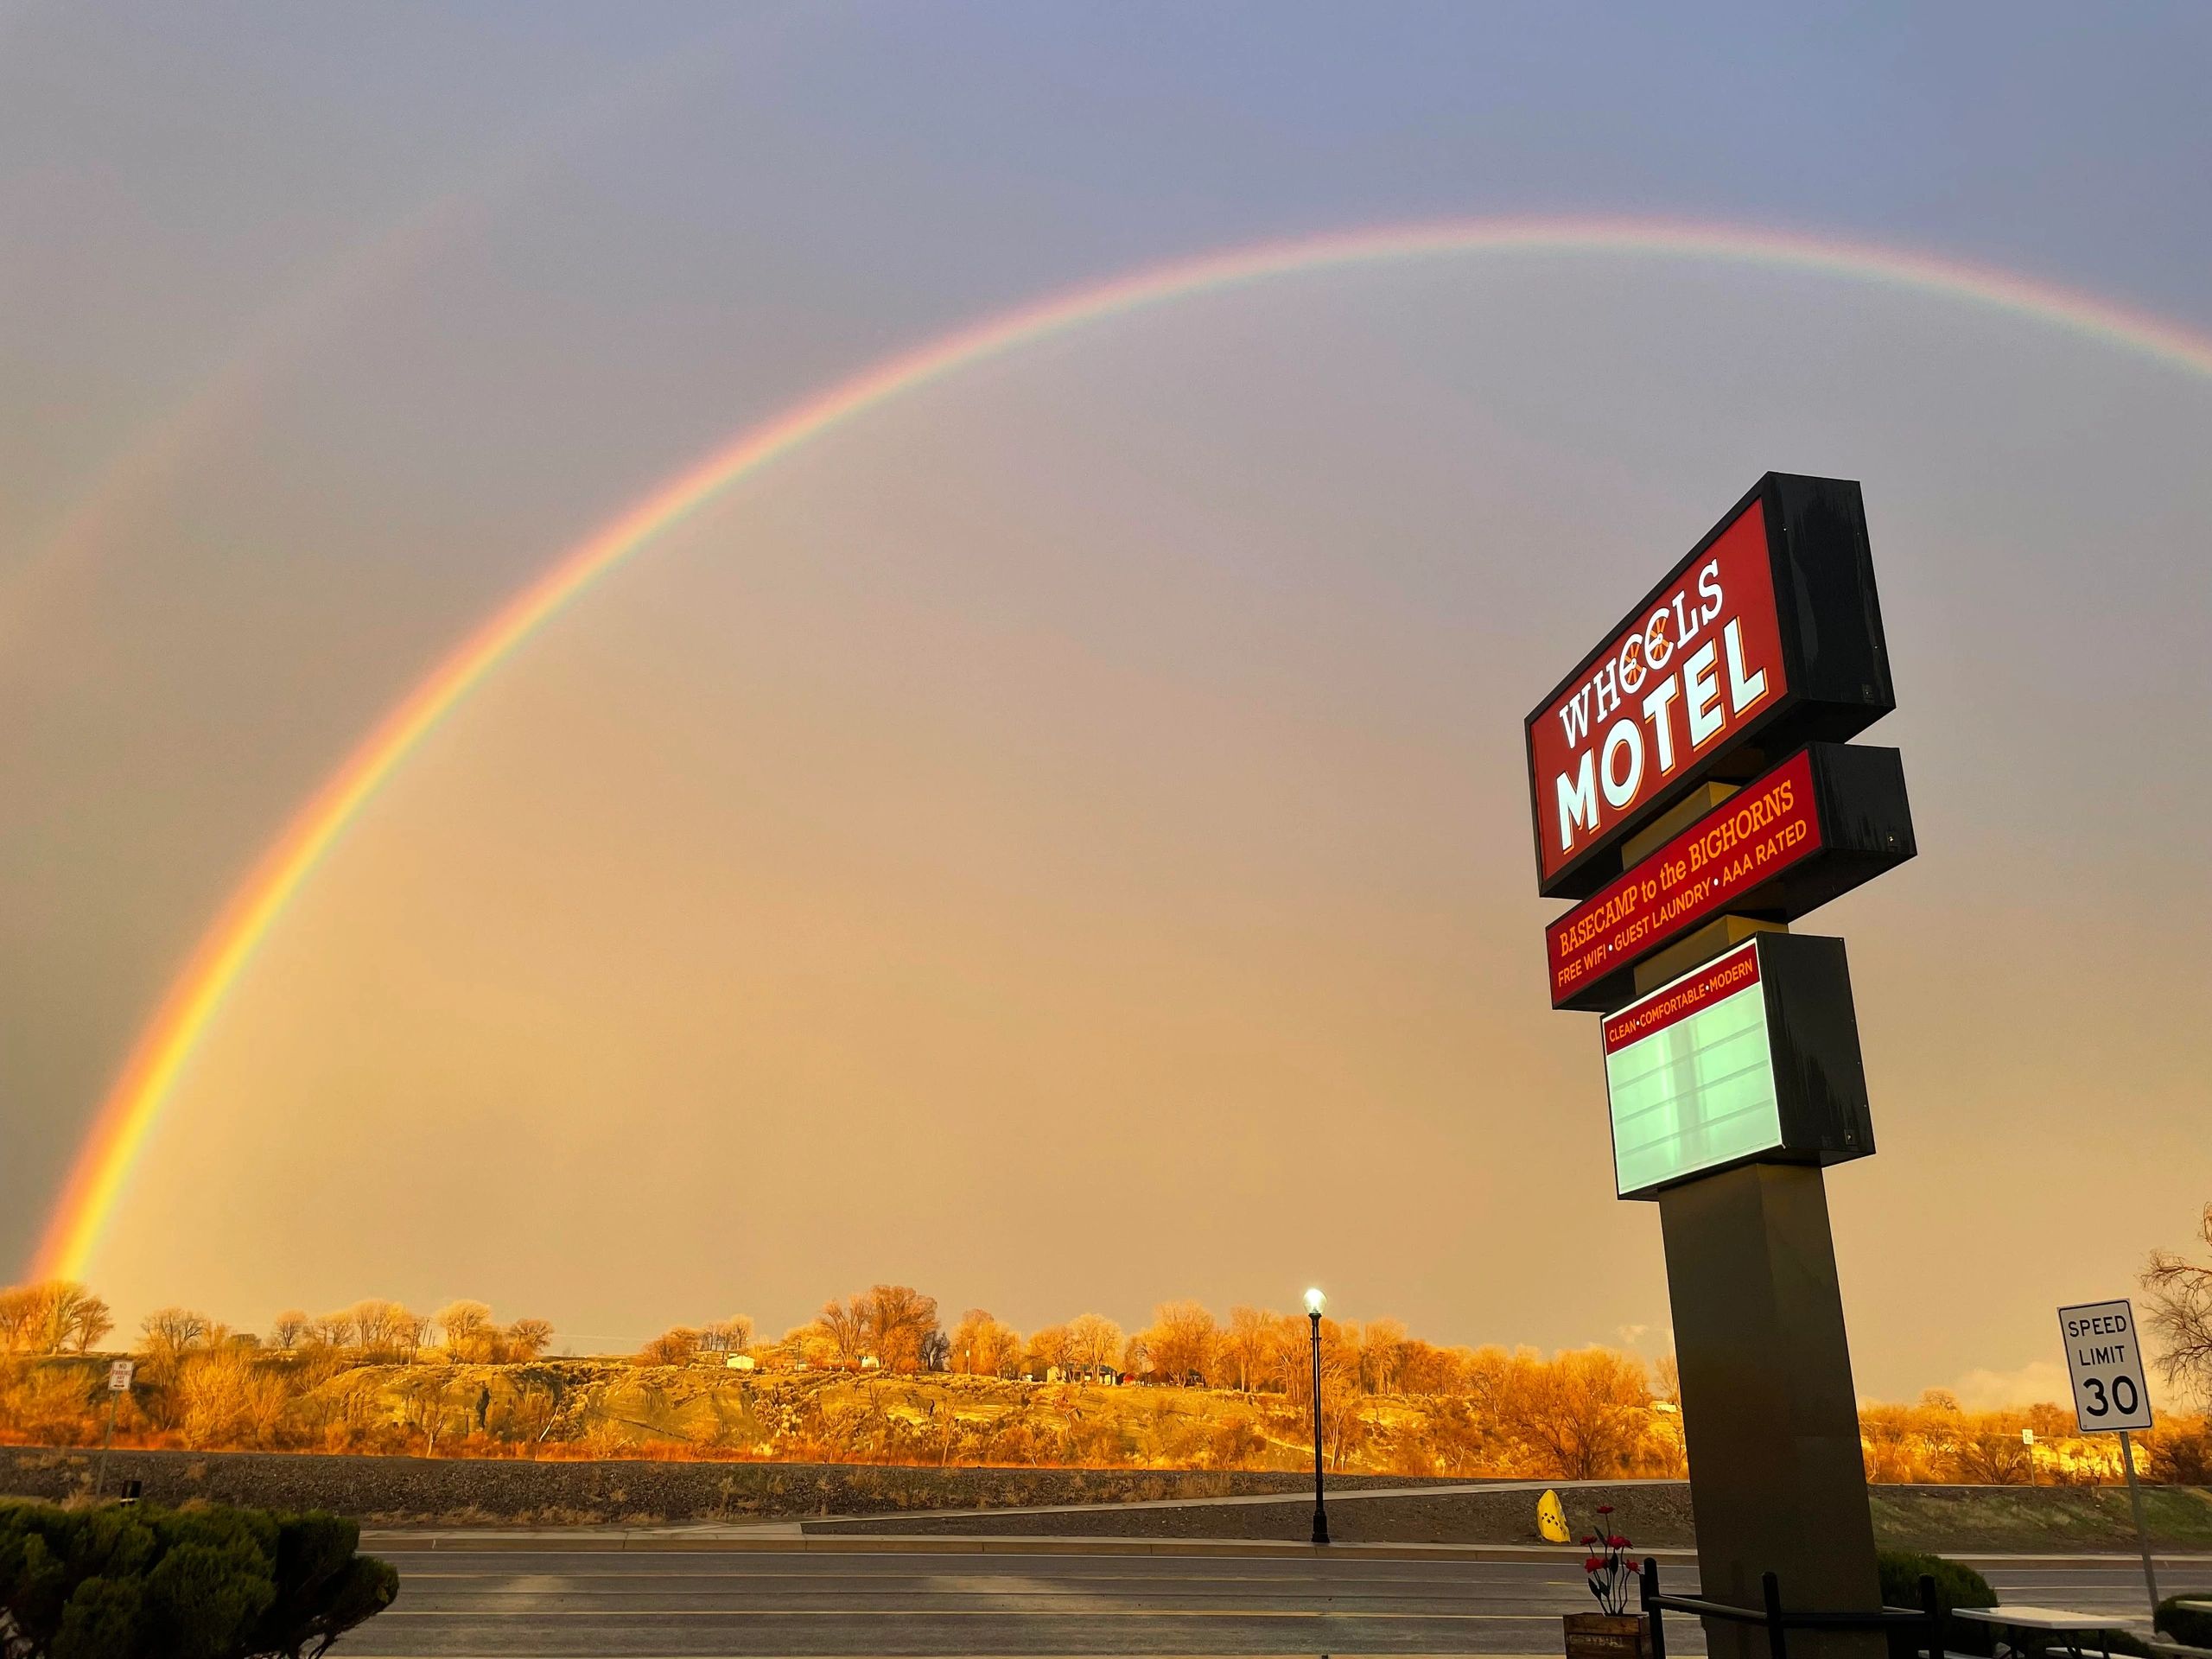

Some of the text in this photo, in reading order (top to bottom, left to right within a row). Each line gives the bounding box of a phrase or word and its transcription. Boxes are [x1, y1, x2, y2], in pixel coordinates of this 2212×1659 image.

[1560, 558, 1723, 748] WHEELS
[1556, 615, 1770, 855] MOTEL
[1558, 819, 1807, 988] FREE WIFI GUEST LAUNDRY AAA RATED
[1559, 779, 1795, 957] BASECAMP to the BIGHORNS
[1609, 958, 1753, 1043] CLEAN COMFORTABLE MODERN
[2068, 1315, 2126, 1338] SPEED
[2079, 1345, 2125, 1366] LIMIT
[2083, 1375, 2139, 1417] 30
